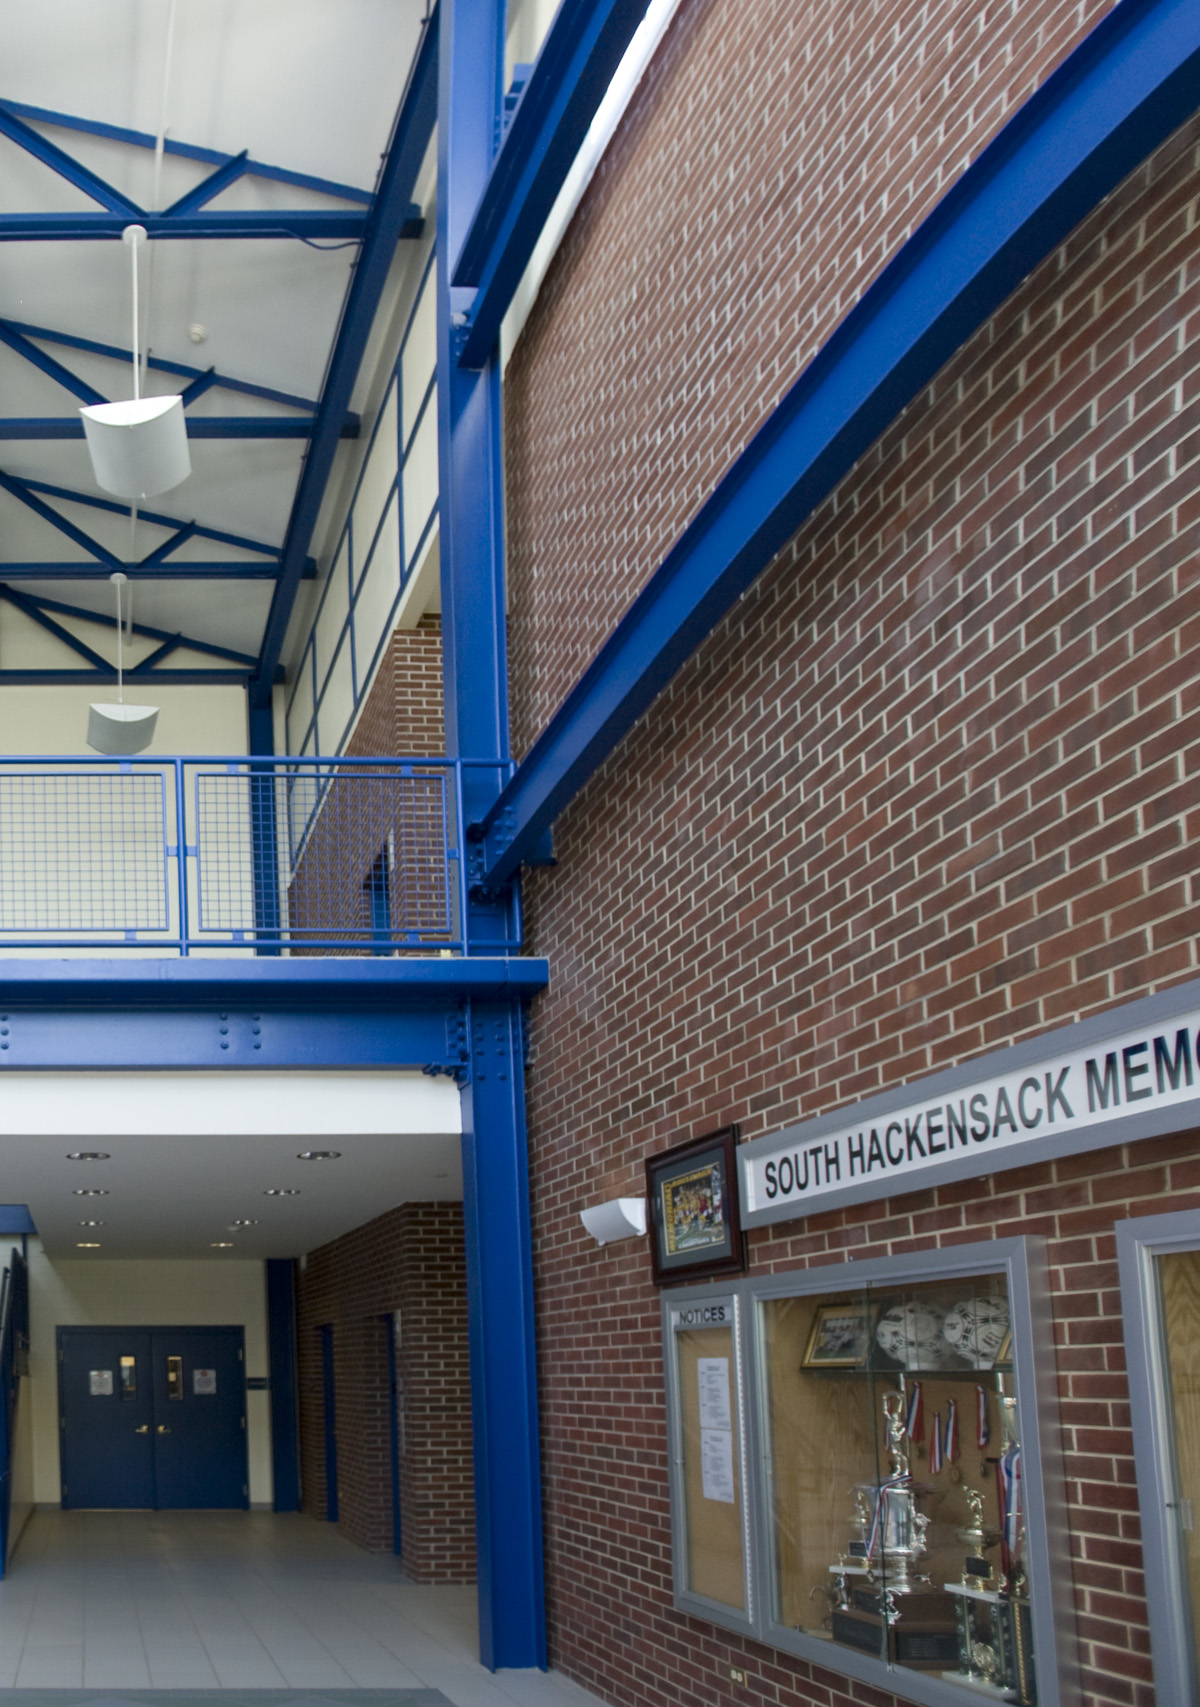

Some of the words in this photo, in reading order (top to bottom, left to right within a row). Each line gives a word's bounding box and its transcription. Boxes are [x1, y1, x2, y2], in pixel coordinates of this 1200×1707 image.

[764, 1140, 841, 1199] SOUTH
[848, 1066, 1075, 1177] HACKENSACK
[1085, 1027, 1200, 1113] MEM
[680, 1306, 725, 1324] NOTICES
